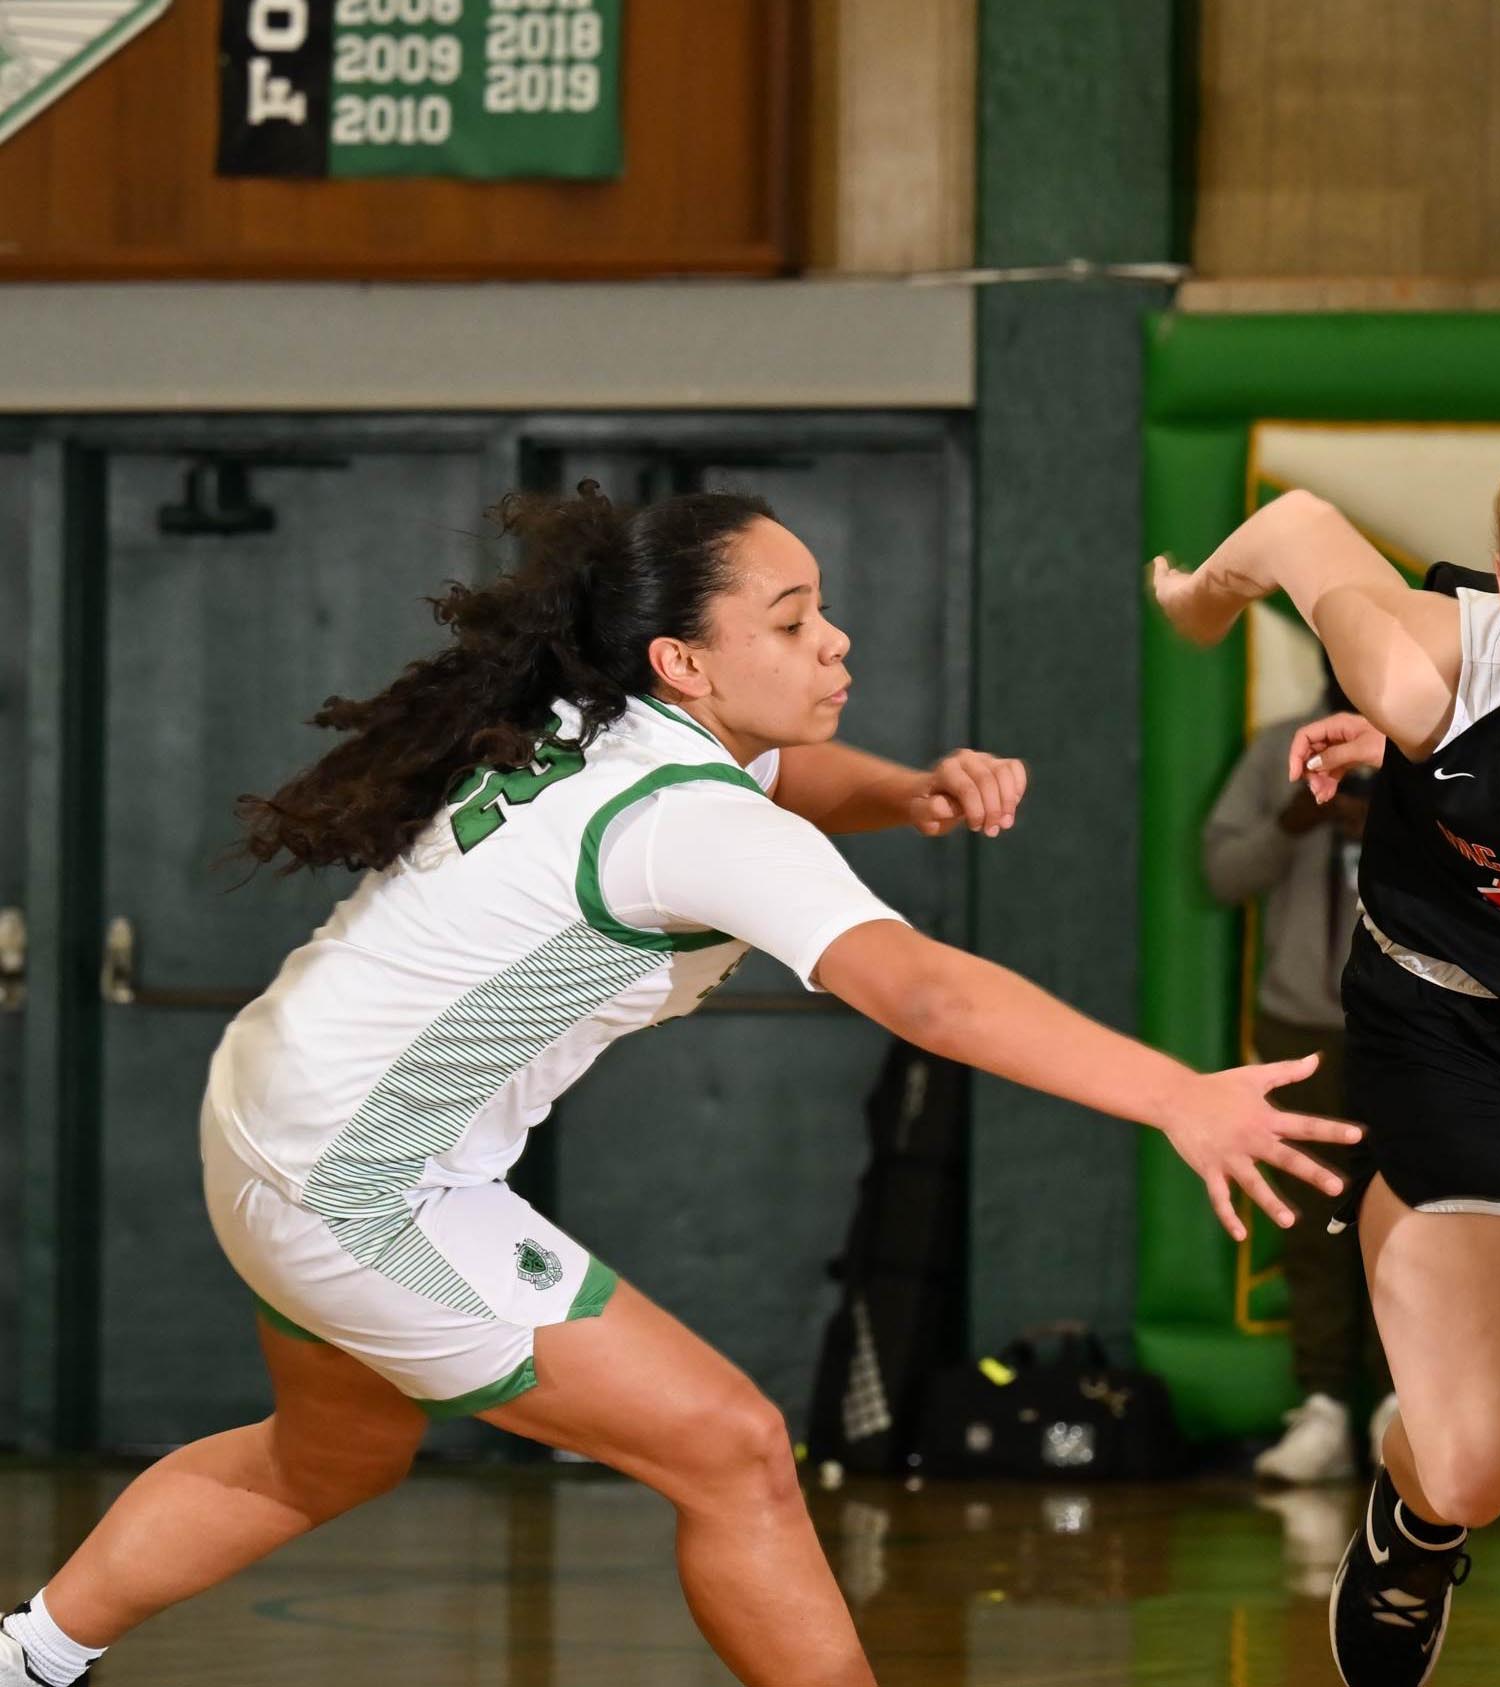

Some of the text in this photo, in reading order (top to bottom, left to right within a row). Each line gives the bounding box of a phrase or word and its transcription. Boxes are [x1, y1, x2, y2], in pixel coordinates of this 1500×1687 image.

[333, 34, 463, 84] 2009
[485, 12, 602, 61] 2018
[483, 64, 601, 113] 2019
[331, 96, 452, 145] 2010
